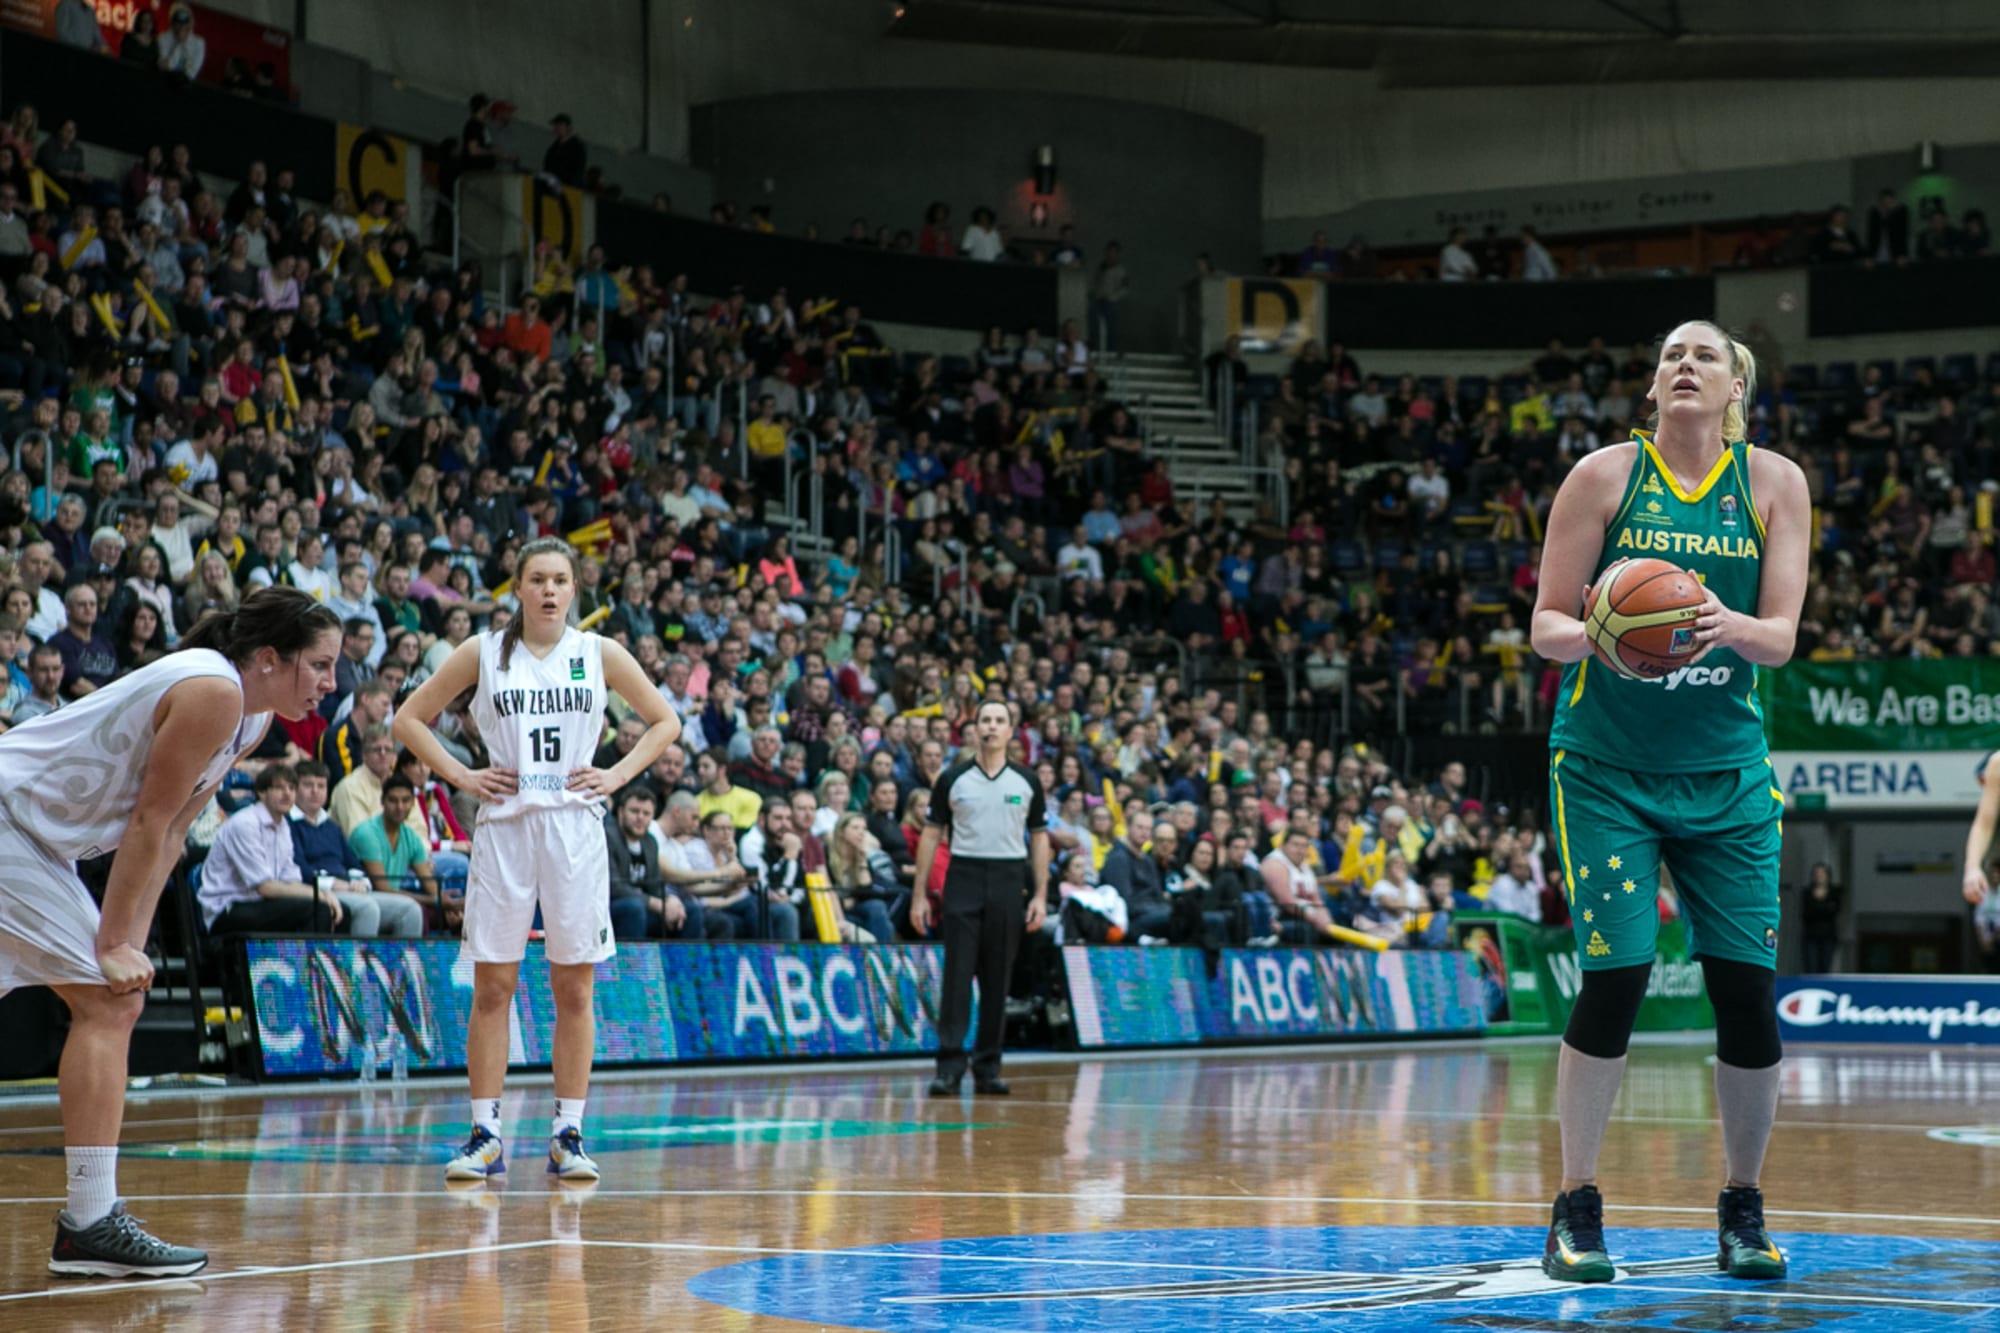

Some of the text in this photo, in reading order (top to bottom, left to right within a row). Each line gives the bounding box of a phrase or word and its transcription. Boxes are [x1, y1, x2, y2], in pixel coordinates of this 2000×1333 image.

[1616, 527, 1759, 559] AUSTRALIA
[493, 687, 593, 718] NEW ZEALAND
[1808, 686, 1869, 726] We
[1875, 687, 1939, 726] Are
[528, 726, 561, 762] 15
[1788, 762, 1928, 795] ARENA
